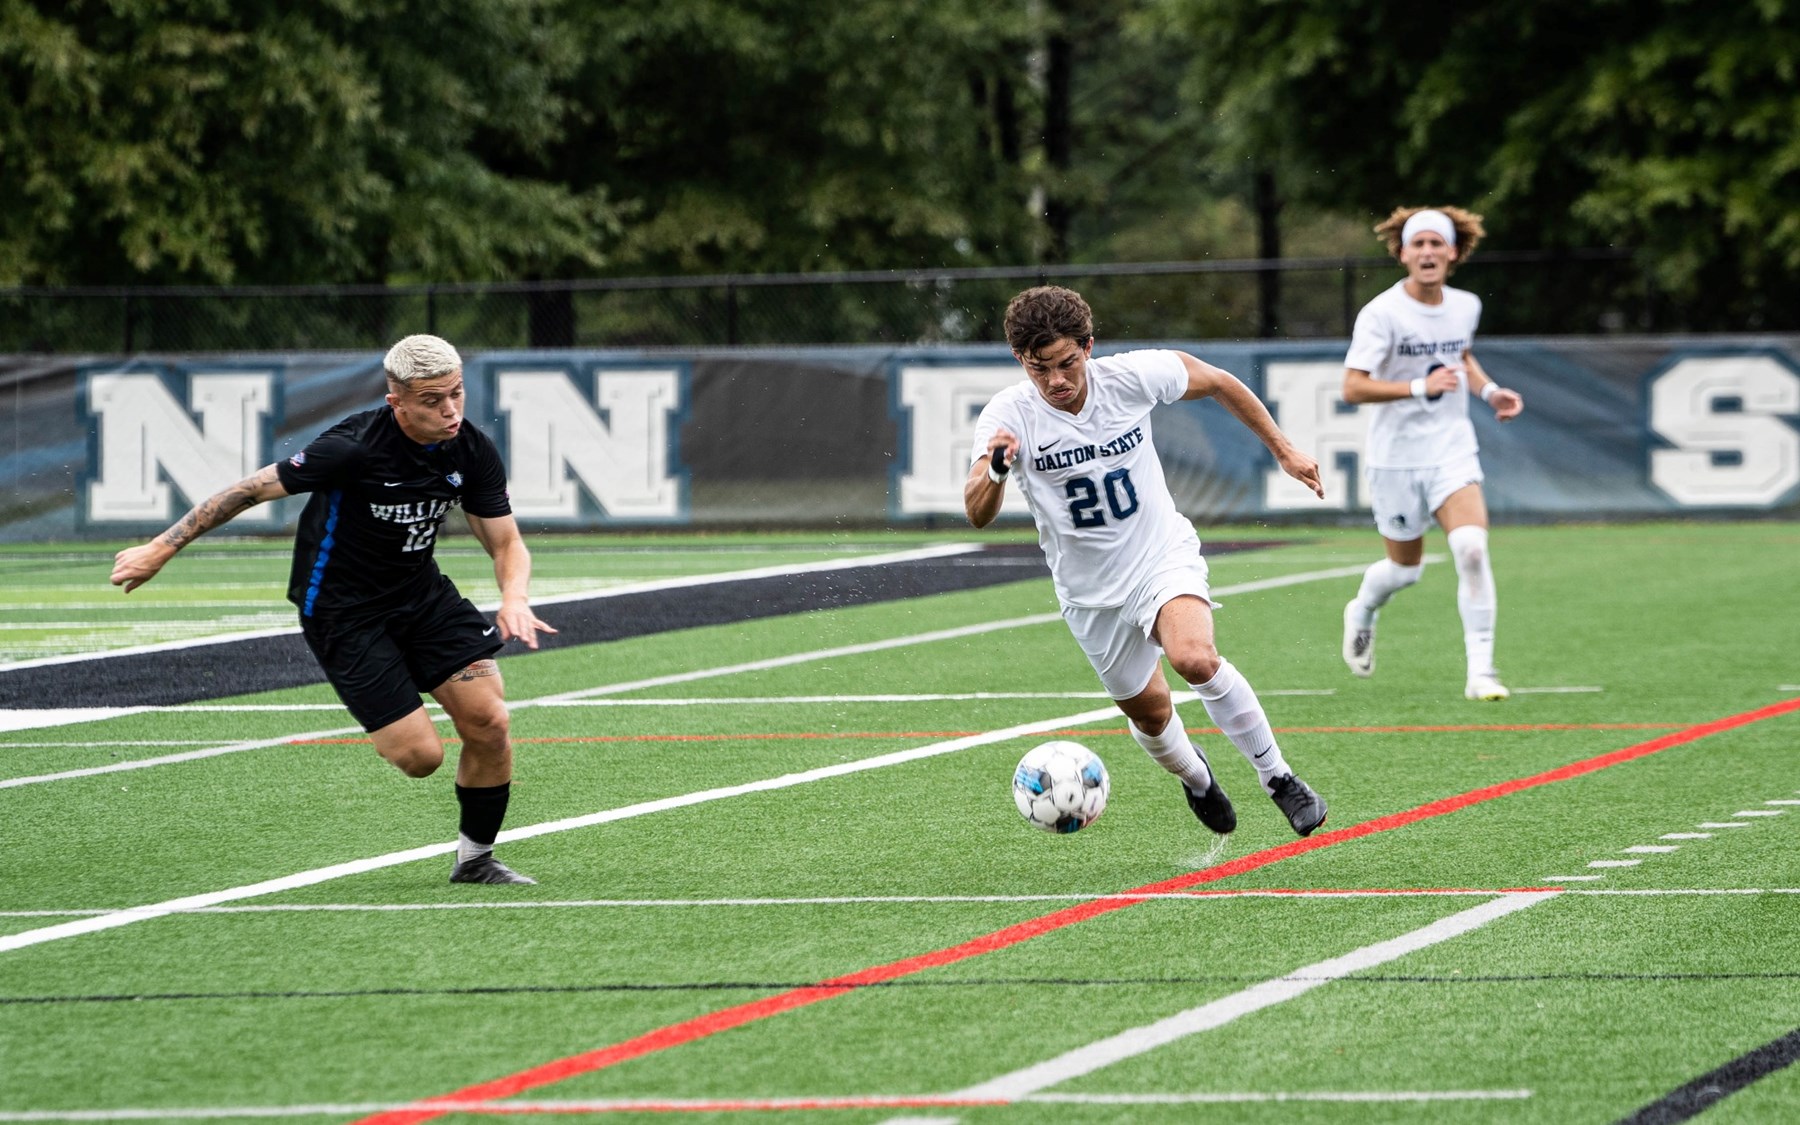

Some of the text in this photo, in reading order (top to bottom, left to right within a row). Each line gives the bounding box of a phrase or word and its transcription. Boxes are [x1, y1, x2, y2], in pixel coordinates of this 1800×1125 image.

[1035, 427, 1144, 471] DALTON STATE
[1065, 468, 1139, 528] 20
[402, 522, 436, 552] 12
